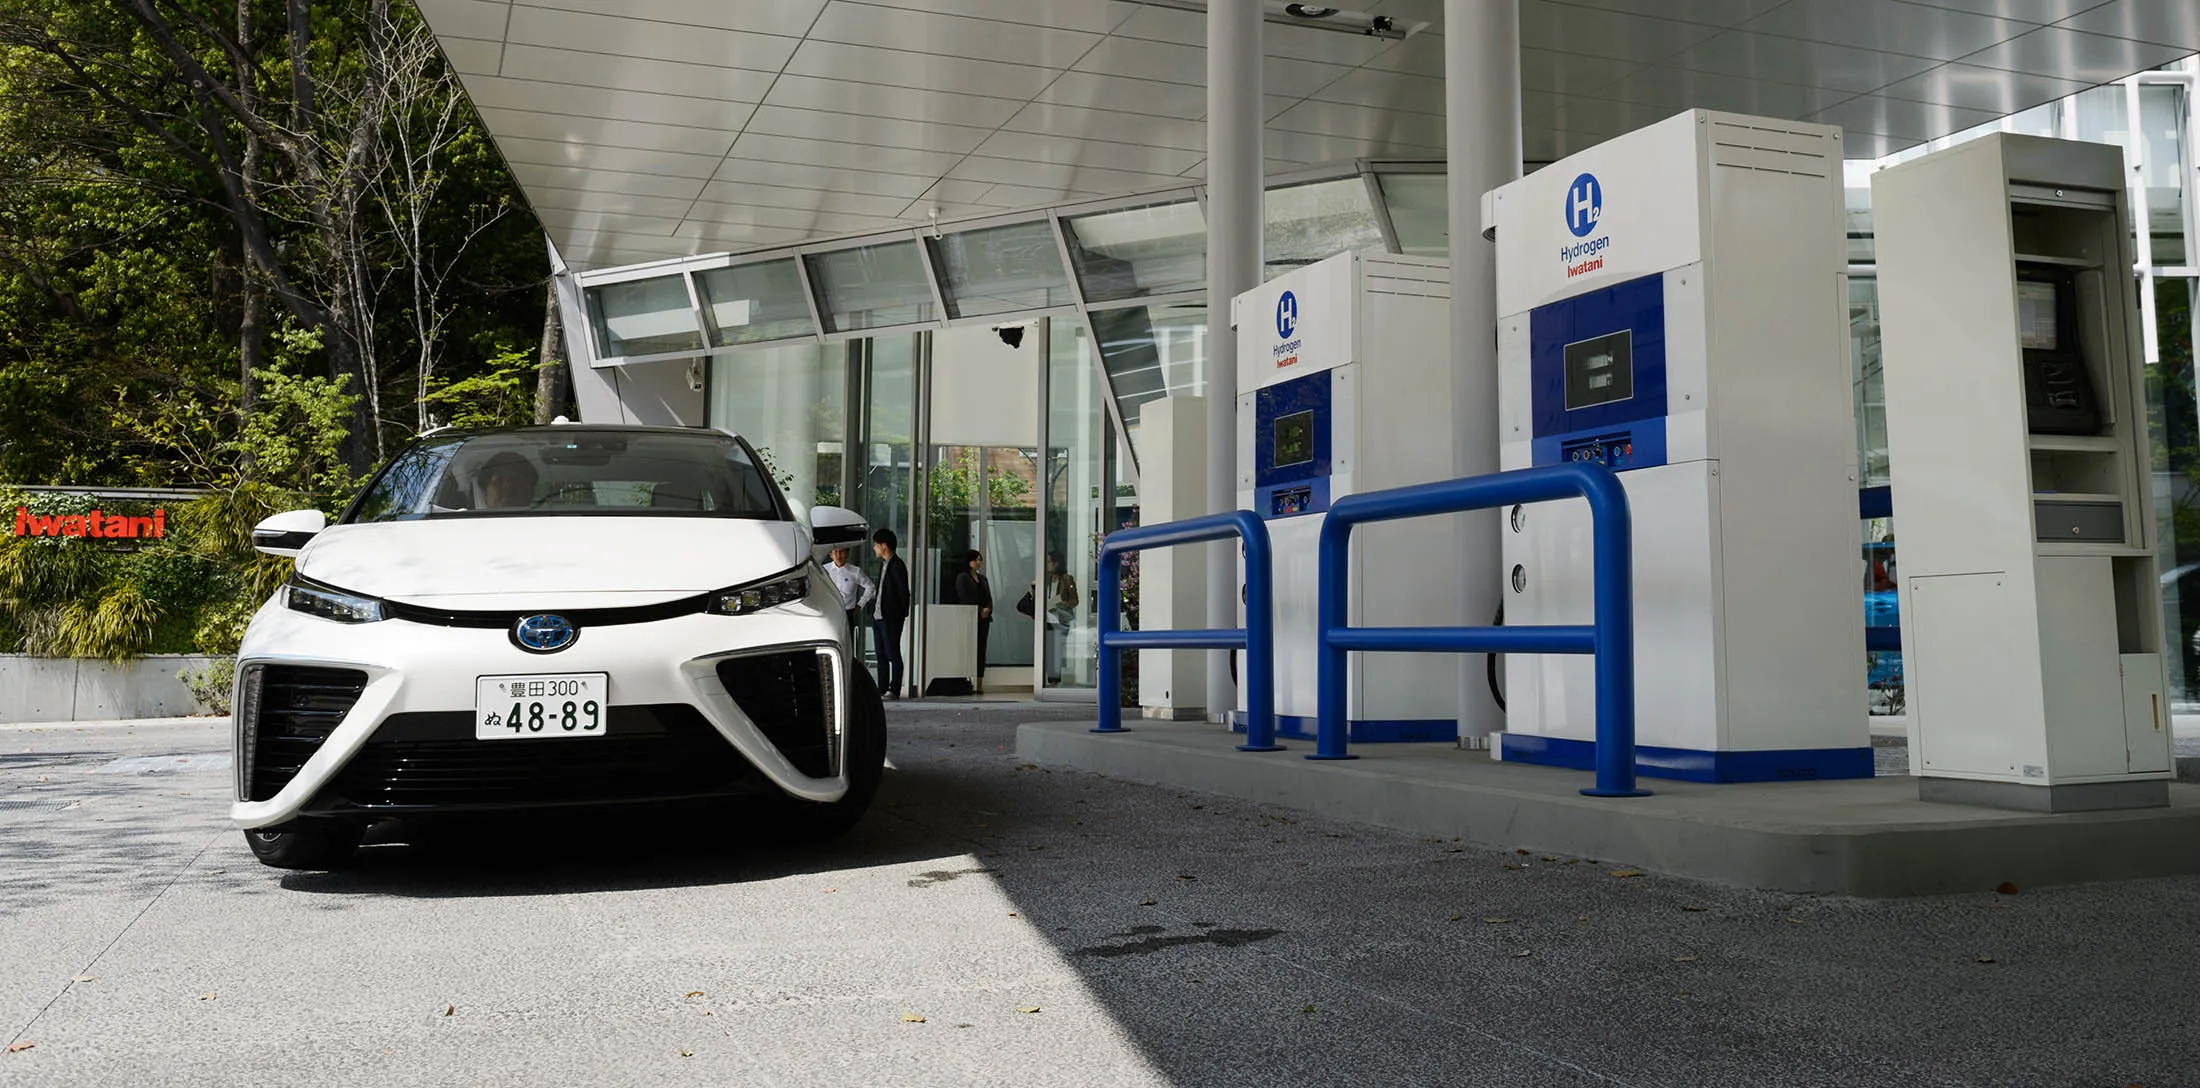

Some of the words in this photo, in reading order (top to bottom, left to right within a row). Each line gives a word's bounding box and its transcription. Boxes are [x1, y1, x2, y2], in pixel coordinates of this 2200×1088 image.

[1560, 236, 1610, 263] Hydrogen
[1567, 256, 1603, 278] Iwatani
[1273, 340, 1301, 358] Hydrogen
[484, 711, 502, 726] ぬ
[506, 700, 600, 733] 48-89
